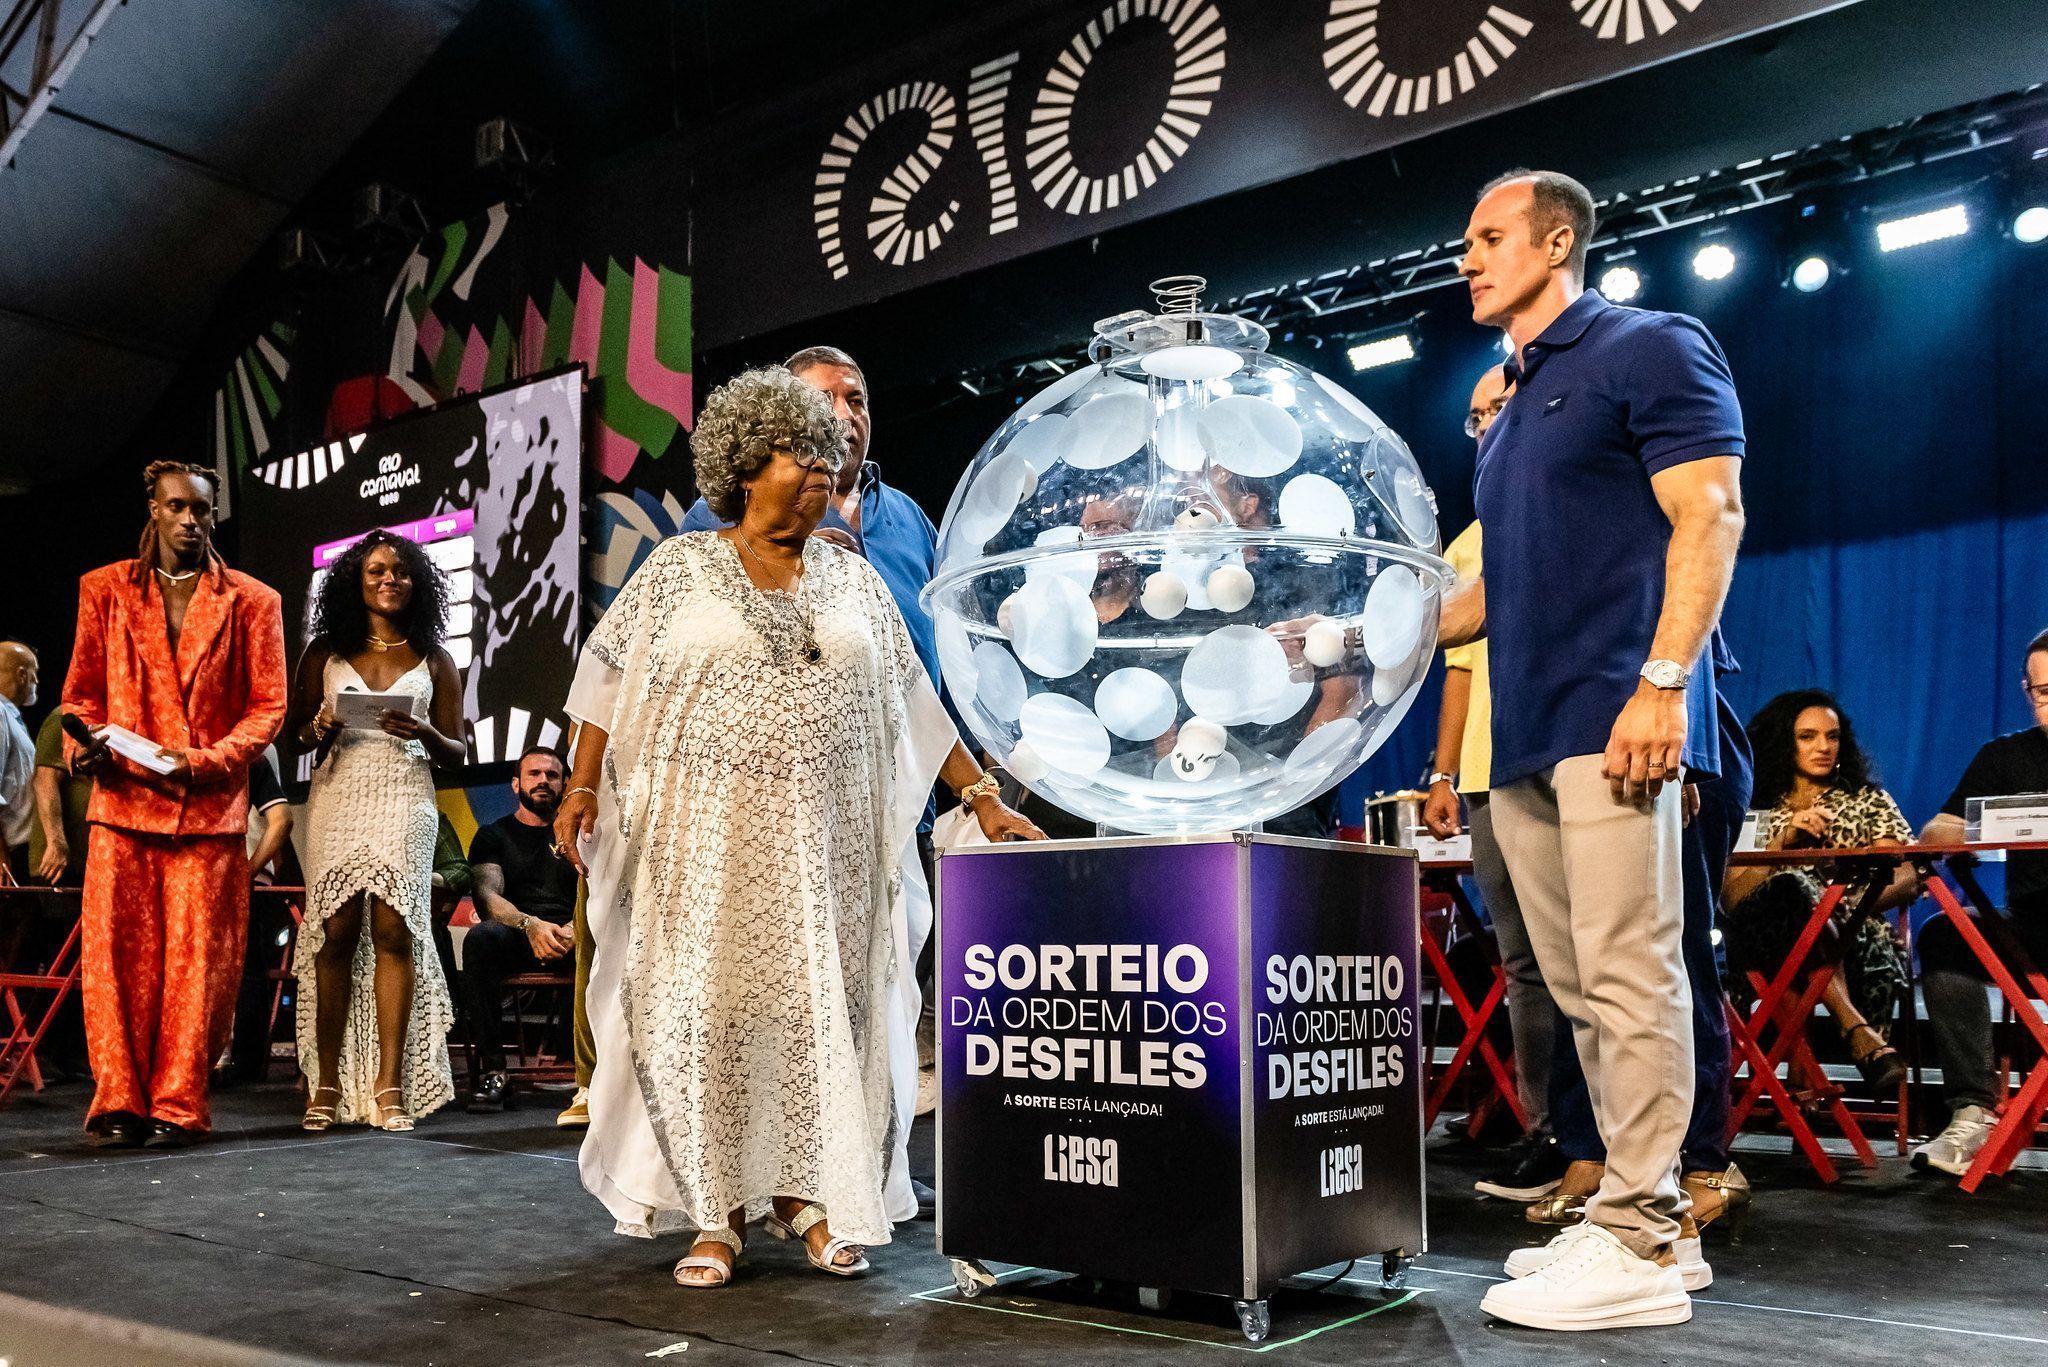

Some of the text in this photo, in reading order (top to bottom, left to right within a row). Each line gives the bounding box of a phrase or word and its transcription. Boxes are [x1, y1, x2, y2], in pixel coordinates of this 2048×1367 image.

[964, 943, 1209, 994] SORTEIO
[1266, 954, 1404, 1004] SORTEIO
[951, 996, 1227, 1036] DA ORDEM DOS
[1257, 1006, 1412, 1047] DA ORDEM DOS
[966, 1033, 1208, 1089] DESFILES
[1268, 1044, 1405, 1100] DESFILES
[1003, 1093, 1163, 1118] A SORTE ESTÁ LANÇADA!
[1294, 1104, 1384, 1127] A SORTE ESTÁ LANÇADA!
